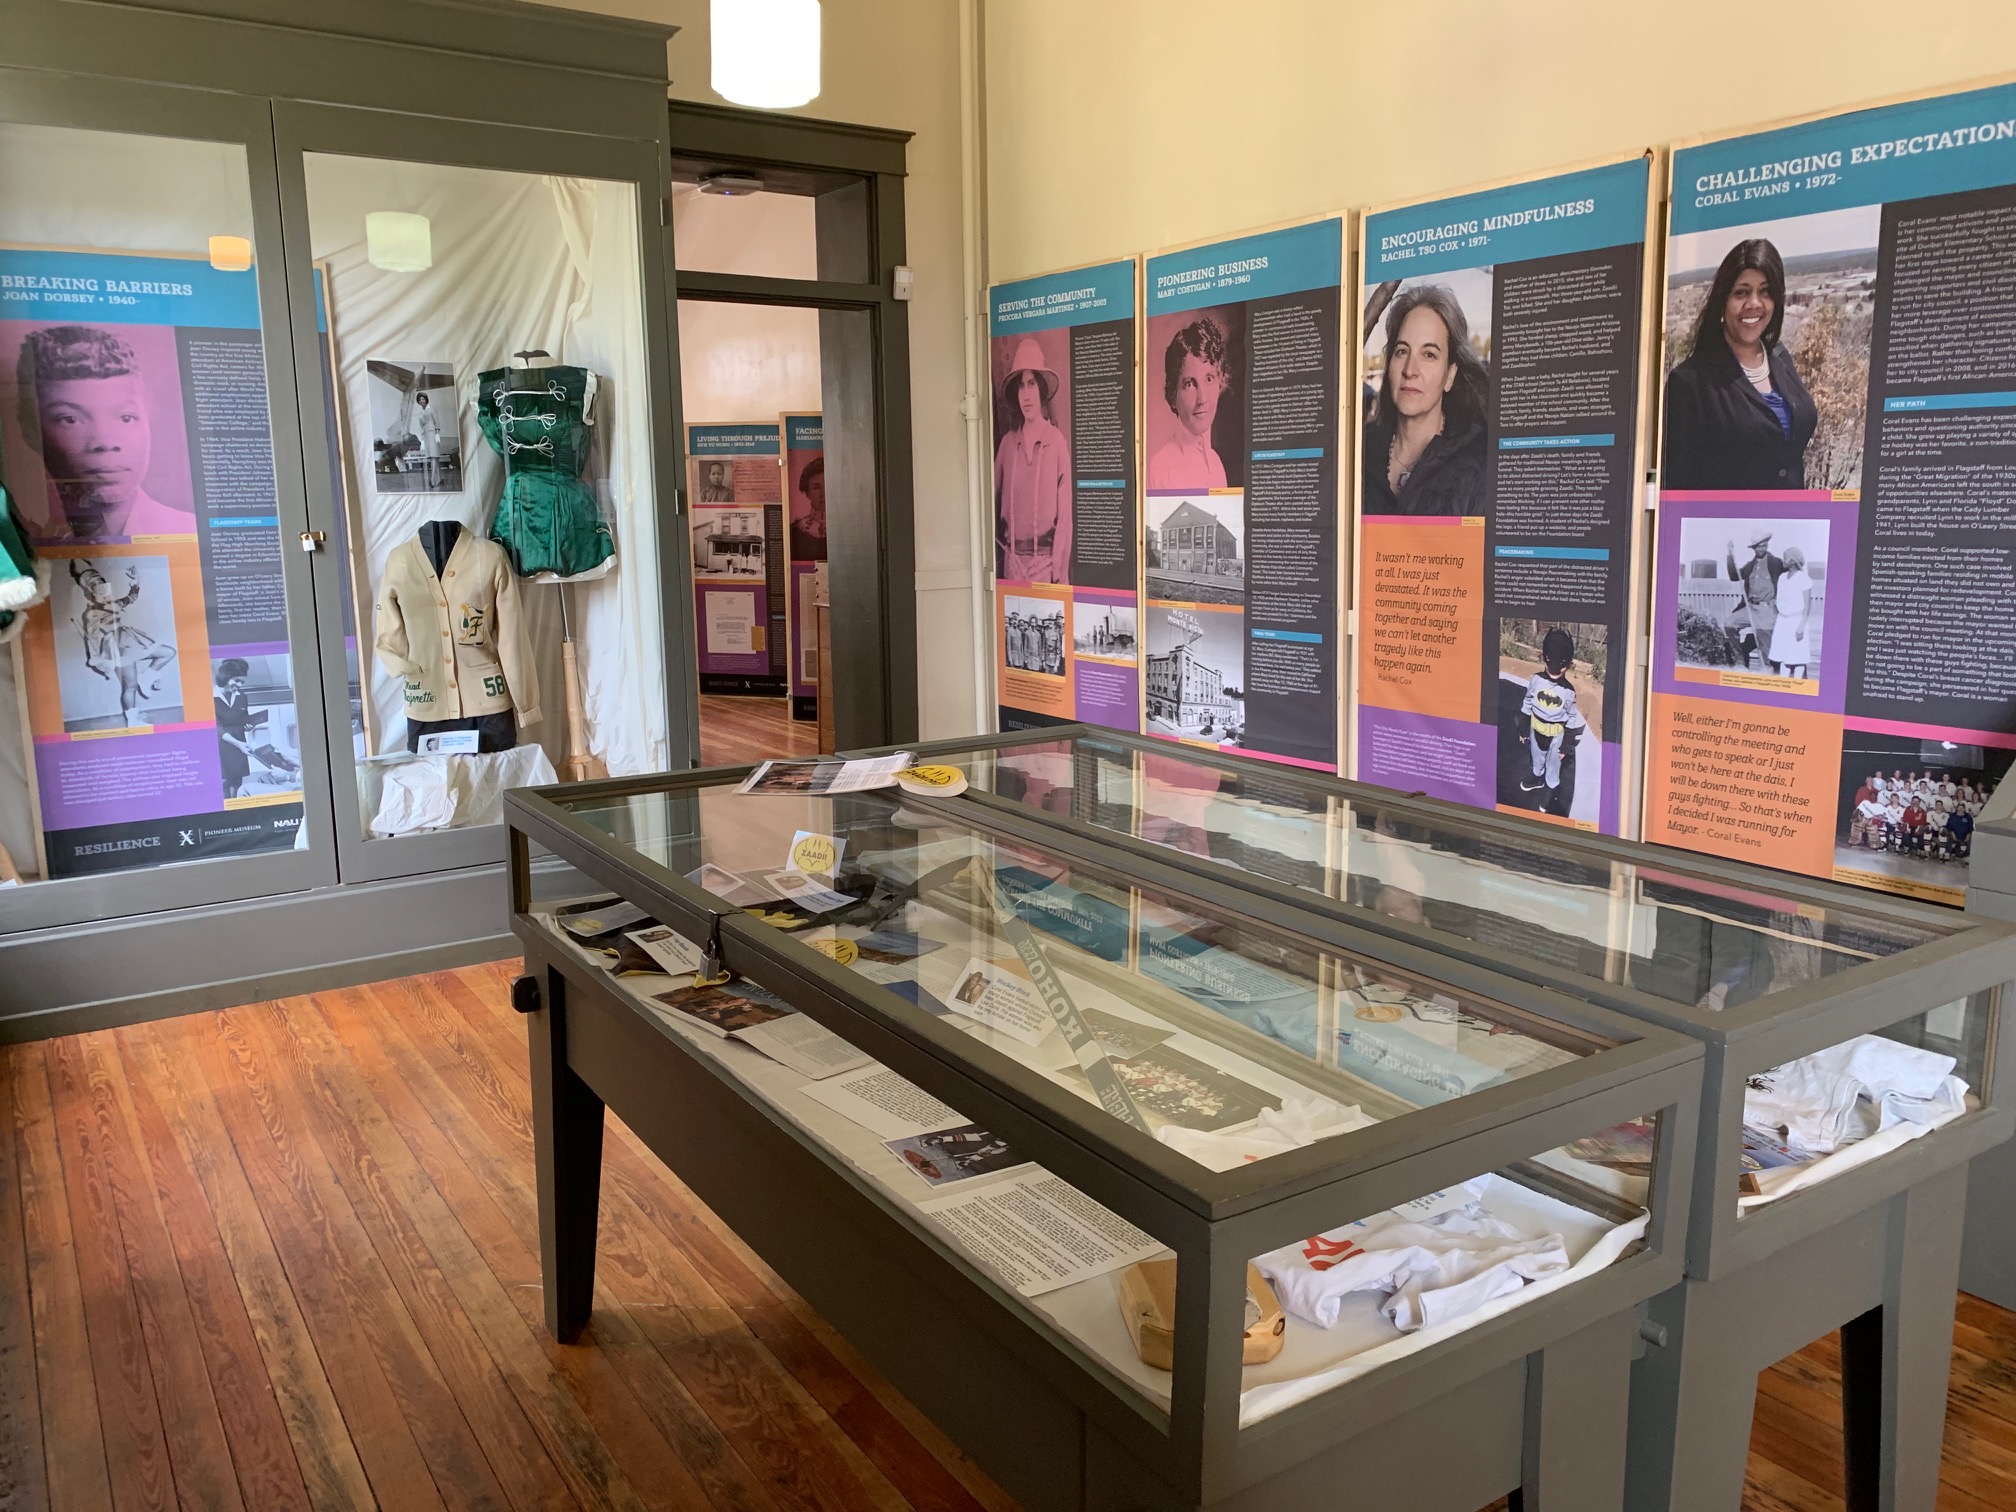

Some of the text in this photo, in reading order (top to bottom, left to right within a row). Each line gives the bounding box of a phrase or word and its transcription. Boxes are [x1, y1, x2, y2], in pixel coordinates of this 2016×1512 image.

[1696, 119, 2016, 193] CHALLENGING EXPECTATION
[1694, 173, 1842, 208] CORAL EVANS 1972-
[1381, 199, 1595, 250] ENCOURAGING MINDFULNESS
[1381, 236, 1491, 263] RACHEL TSO COX 1971-
[1157, 256, 1268, 288] PIONEERING BUSINESS
[0, 275, 192, 296] BREAKING BARRIERS
[1157, 274, 1251, 298] MARY COSTIGAN 1879-1960
[3, 292, 141, 305] JOAN DORSEY 1940-
[998, 287, 1096, 313] SERVING THE COMMUNITY
[998, 312, 1022, 322] PROCORA
[1022, 309, 1046, 318] VERGARA
[1047, 304, 1074, 315] MARTINEZ
[1376, 552, 1464, 568] It wasn't me working
[1376, 568, 1440, 582] at all. I was just
[1375, 582, 1467, 598] devastated. It was the
[1173, 608, 1198, 624] HOTEL
[1375, 599, 1457, 616] community coming
[1168, 615, 1186, 628] MONTE
[1375, 613, 1458, 632] together and saying
[1375, 629, 1456, 644] we can't let another
[1374, 643, 1441, 658] tragedy like this
[1374, 656, 1432, 674] happen again.
[483, 675, 505, 697] 58
[1378, 674, 1412, 685] Rachel Cox
[1008, 720, 1041, 729] RESILIEN
[1673, 712, 1790, 736] Well, either I'm gonna be
[1672, 729, 1806, 755] controlling the meeting and
[1671, 744, 1794, 771] who gets to speak or I just
[1671, 759, 1795, 787] won't be here at the dais, I
[1670, 775, 1810, 806] will be down there with these
[1668, 791, 1812, 824] guys fighting... So that's when
[204, 824, 262, 836] PIONEER MUSEUM
[274, 820, 299, 828] NAU
[1668, 805, 1797, 838] I decided I was running for
[1667, 820, 1761, 847] Mayor. Coral Evans
[74, 836, 161, 856] RESILIENCE
[997, 978, 1030, 997] Hockey Stick
[1030, 960, 1083, 1042] KOHO
